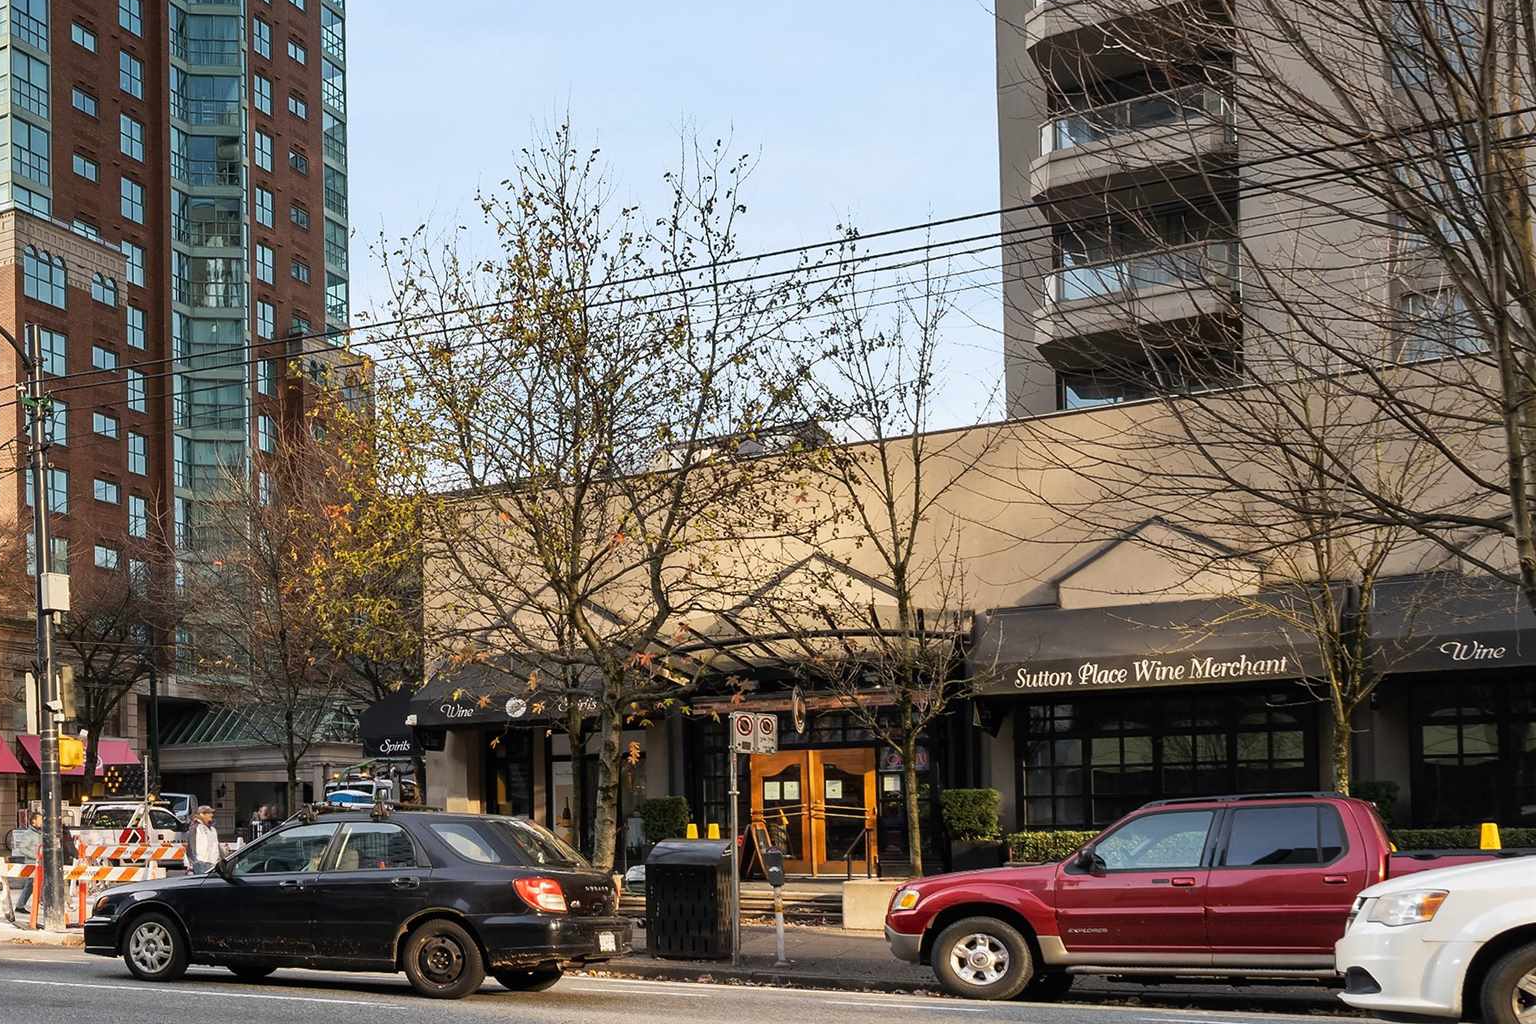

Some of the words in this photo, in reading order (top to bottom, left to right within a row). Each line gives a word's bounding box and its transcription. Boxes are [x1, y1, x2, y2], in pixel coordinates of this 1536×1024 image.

[1440, 641, 1506, 660] Wine
[1015, 668, 1073, 688] Sutton
[1079, 662, 1127, 685] Place
[1133, 659, 1185, 682] Wine
[1190, 654, 1289, 679] Merchant
[440, 703, 474, 718] Wine
[379, 738, 411, 755] Spirits
